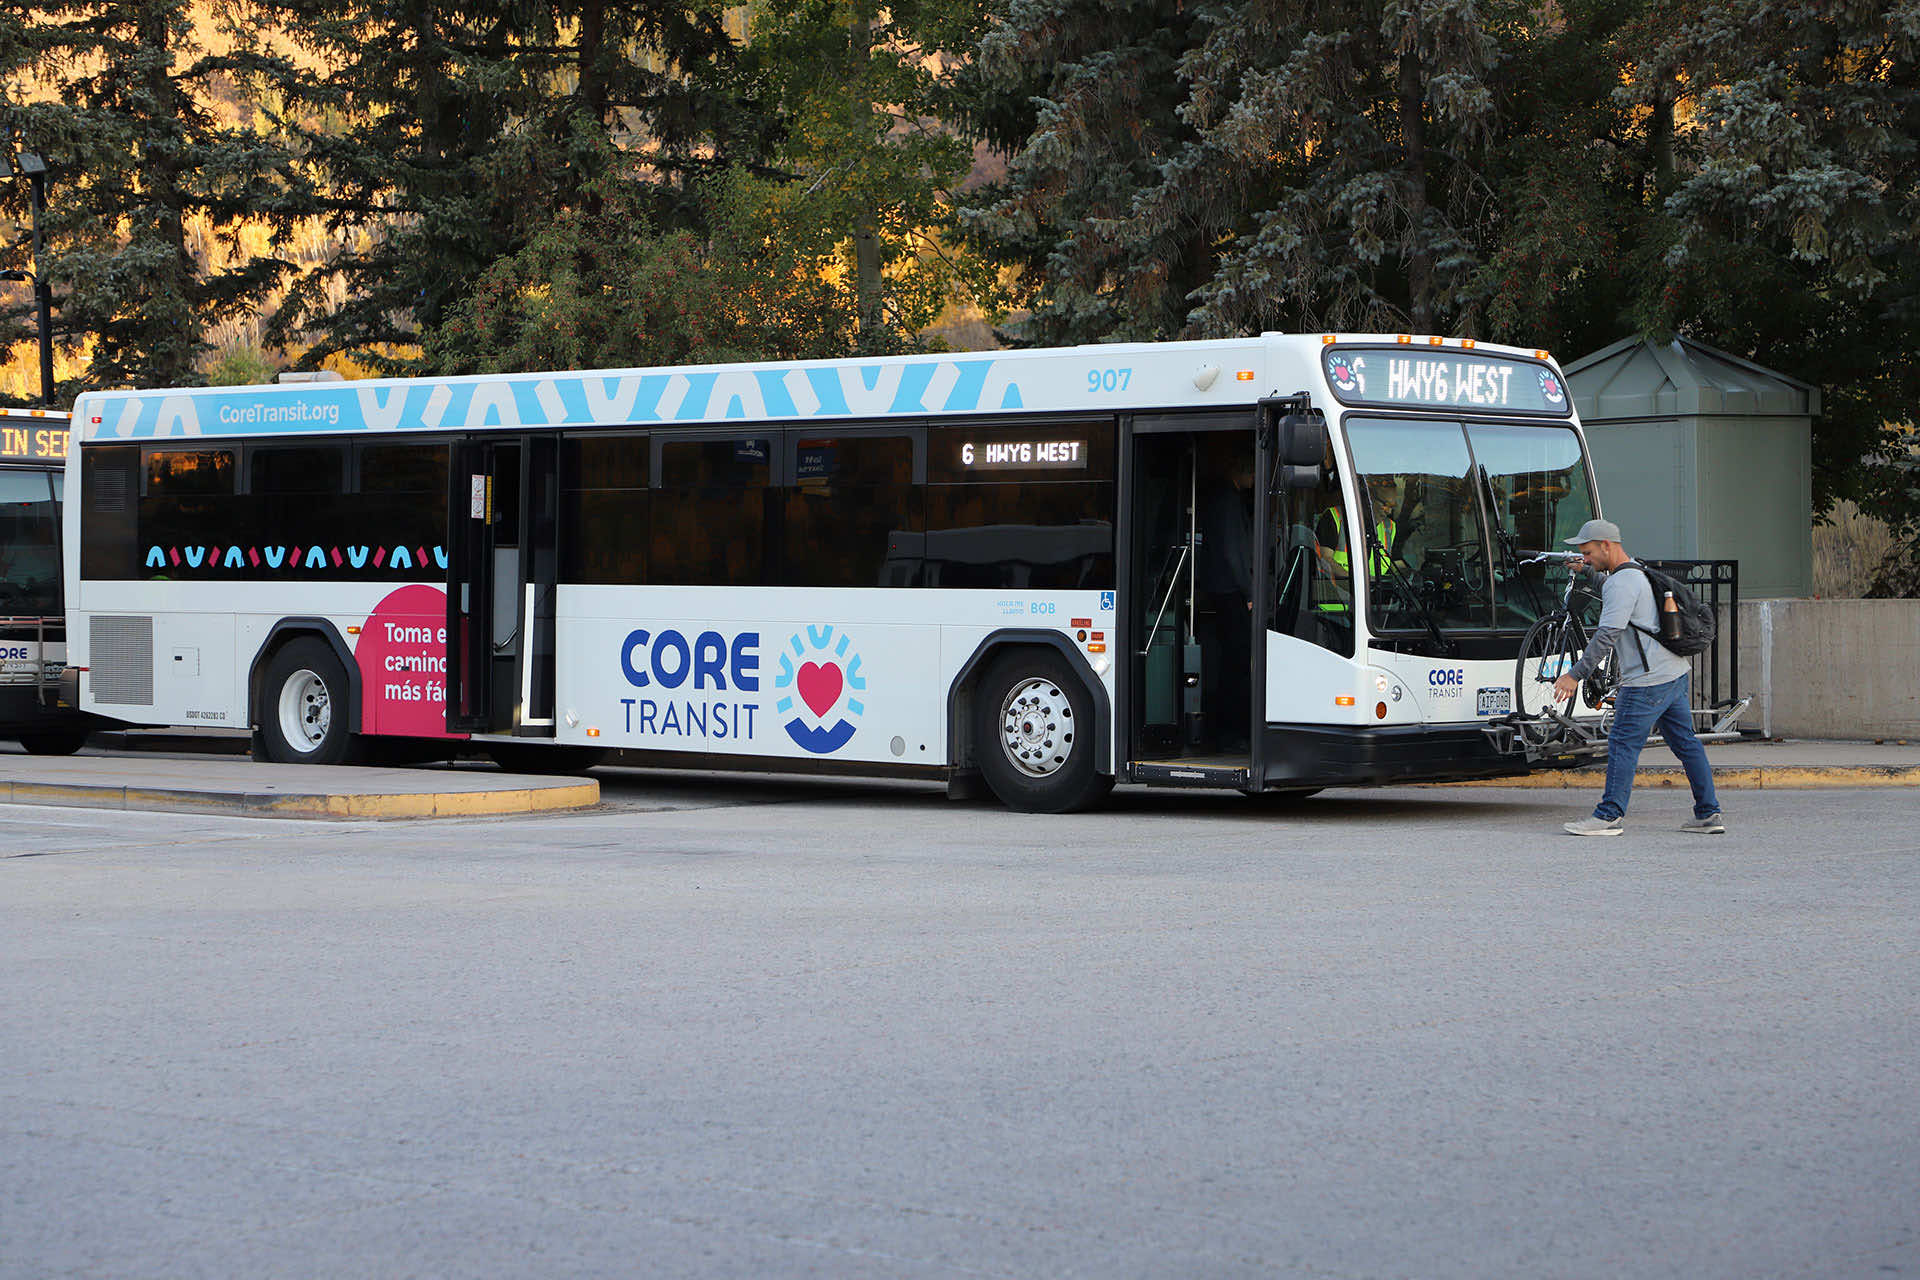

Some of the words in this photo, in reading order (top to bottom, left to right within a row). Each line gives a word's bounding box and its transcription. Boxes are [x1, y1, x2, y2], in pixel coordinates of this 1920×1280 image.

[1087, 368, 1132, 392] 907
[1388, 358, 1449, 401] HWY6
[1455, 363, 1513, 405] WEST
[219, 400, 340, 425] CoreTransit.org
[1, 428, 29, 456] IN
[961, 443, 975, 465] 6
[986, 443, 1032, 463] HWY6
[1036, 442, 1080, 462] WEST
[1030, 602, 1056, 615] BOB
[383, 622, 432, 643] Toma
[620, 629, 760, 692] CORE
[1428, 669, 1463, 686] CORE
[385, 680, 421, 701] más
[1428, 687, 1463, 698] TRANSIT
[620, 698, 759, 740] TRANSIT
